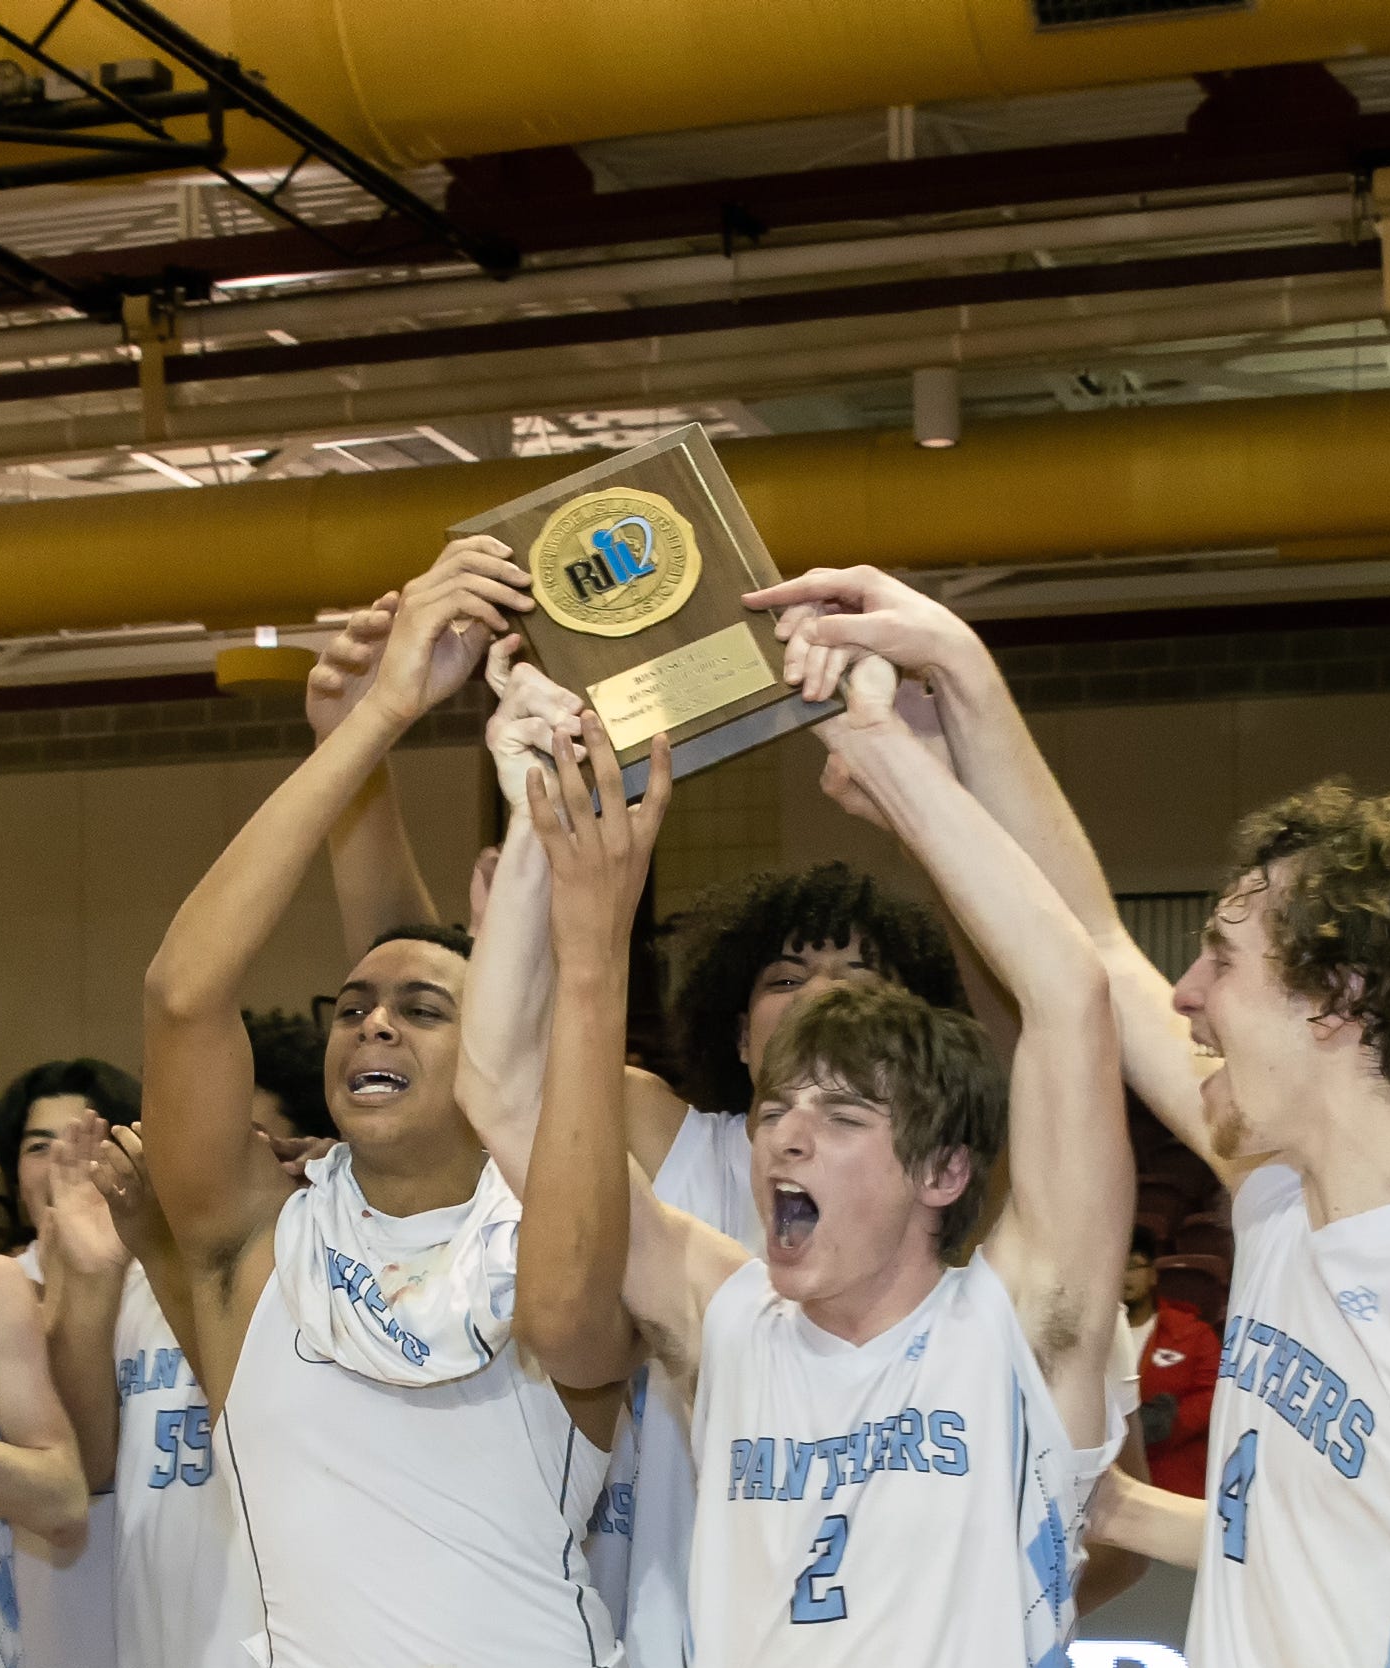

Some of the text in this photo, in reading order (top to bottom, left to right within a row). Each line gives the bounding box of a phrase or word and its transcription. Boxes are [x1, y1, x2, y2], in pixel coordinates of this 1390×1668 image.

[148, 1405, 212, 1489] 55
[727, 1407, 969, 1501] PANTHERS
[1218, 1427, 1258, 1564] 4
[789, 1513, 849, 1625] 2
